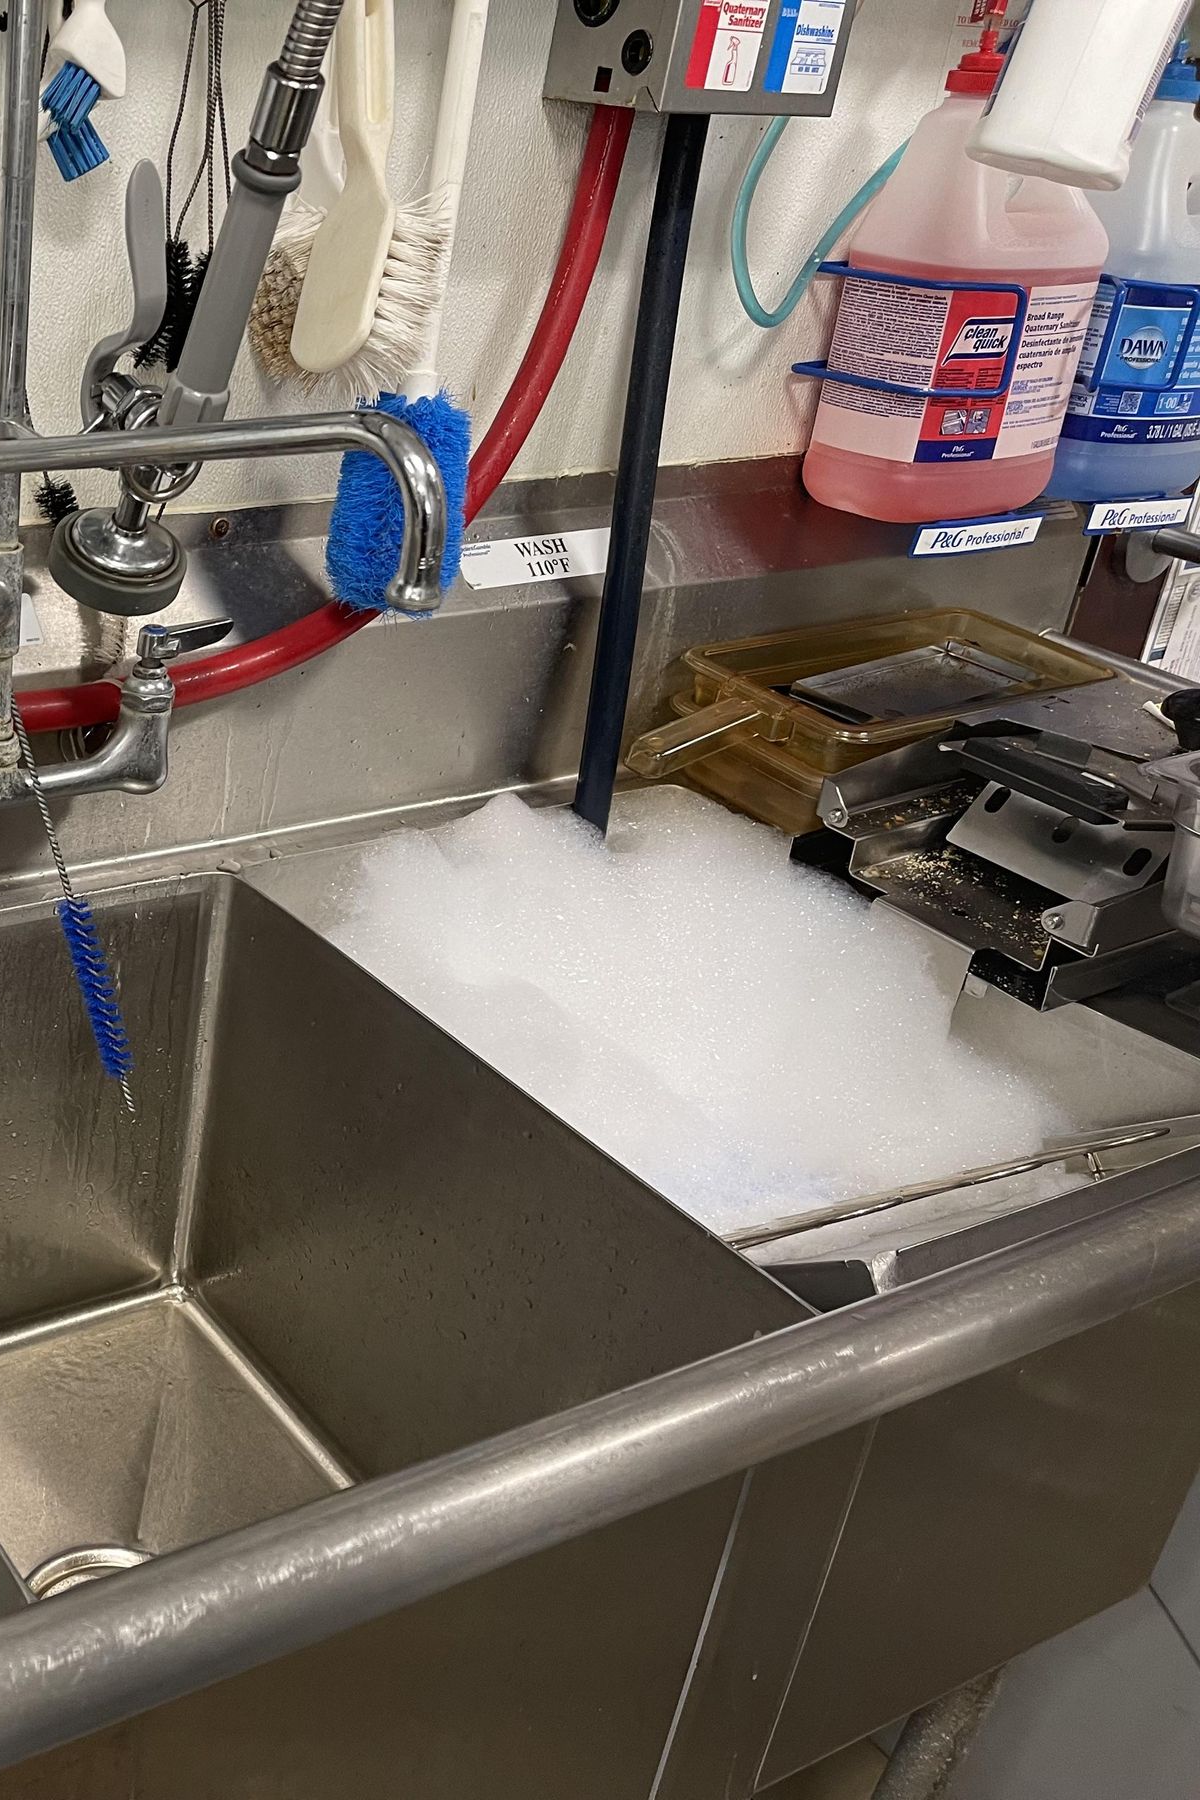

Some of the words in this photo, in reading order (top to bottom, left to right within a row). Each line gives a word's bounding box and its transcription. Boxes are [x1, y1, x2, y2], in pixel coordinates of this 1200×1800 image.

[723, 2, 766, 19] Quaternary
[728, 15, 763, 28] Sanitizer
[1027, 311, 1046, 321] Broad
[1047, 311, 1064, 322] Range
[964, 325, 999, 341] clean
[1024, 322, 1059, 333] Quaternary
[973, 335, 1008, 352] quick
[1021, 337, 1062, 348] Desinfectante
[1120, 338, 1168, 356] DAWN
[1019, 348, 1053, 359] cuaternario
[1016, 361, 1043, 371] espectro
[1099, 508, 1130, 527] P&G
[514, 538, 568, 558] WASH
[930, 531, 965, 549] P&G
[526, 558, 570, 577] 110°F
